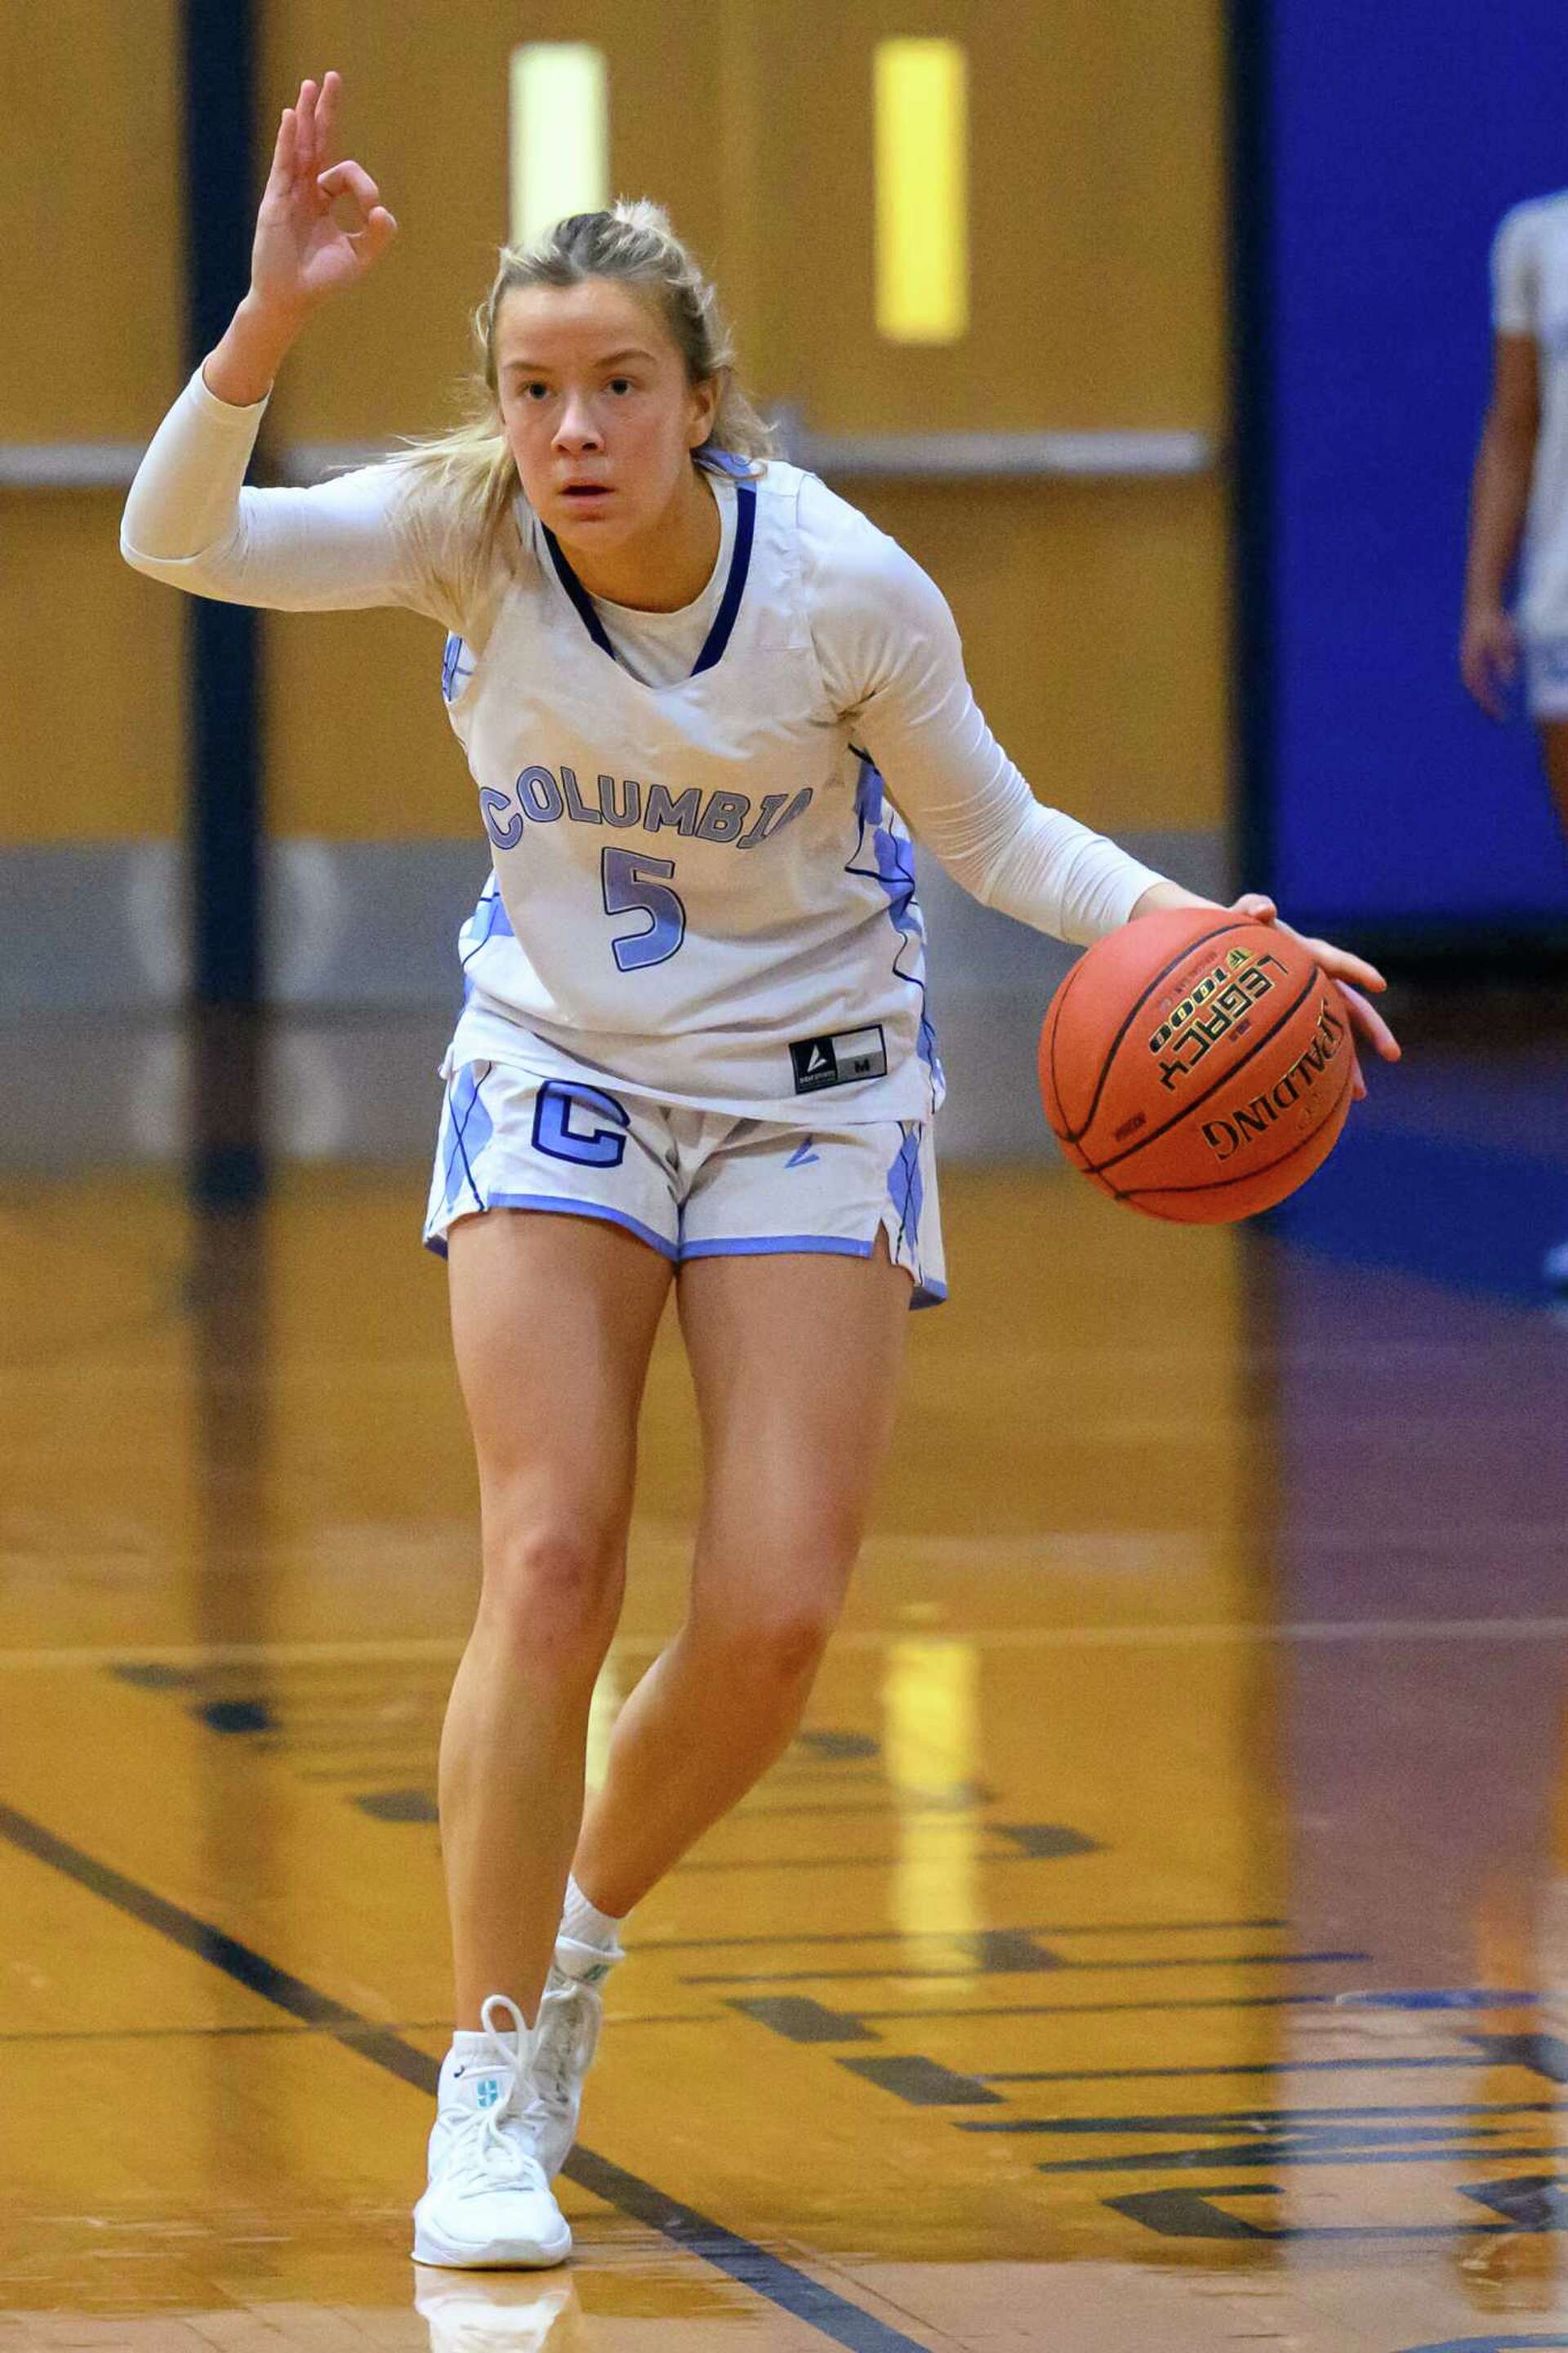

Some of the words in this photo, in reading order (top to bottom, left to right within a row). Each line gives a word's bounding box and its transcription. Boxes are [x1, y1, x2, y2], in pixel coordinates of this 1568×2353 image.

[600, 846, 687, 973] 5
[1149, 966, 1231, 1055] 1000
[1158, 955, 1289, 1091] LEGACY
[853, 1058, 871, 1074] M
[531, 1080, 630, 1169] C
